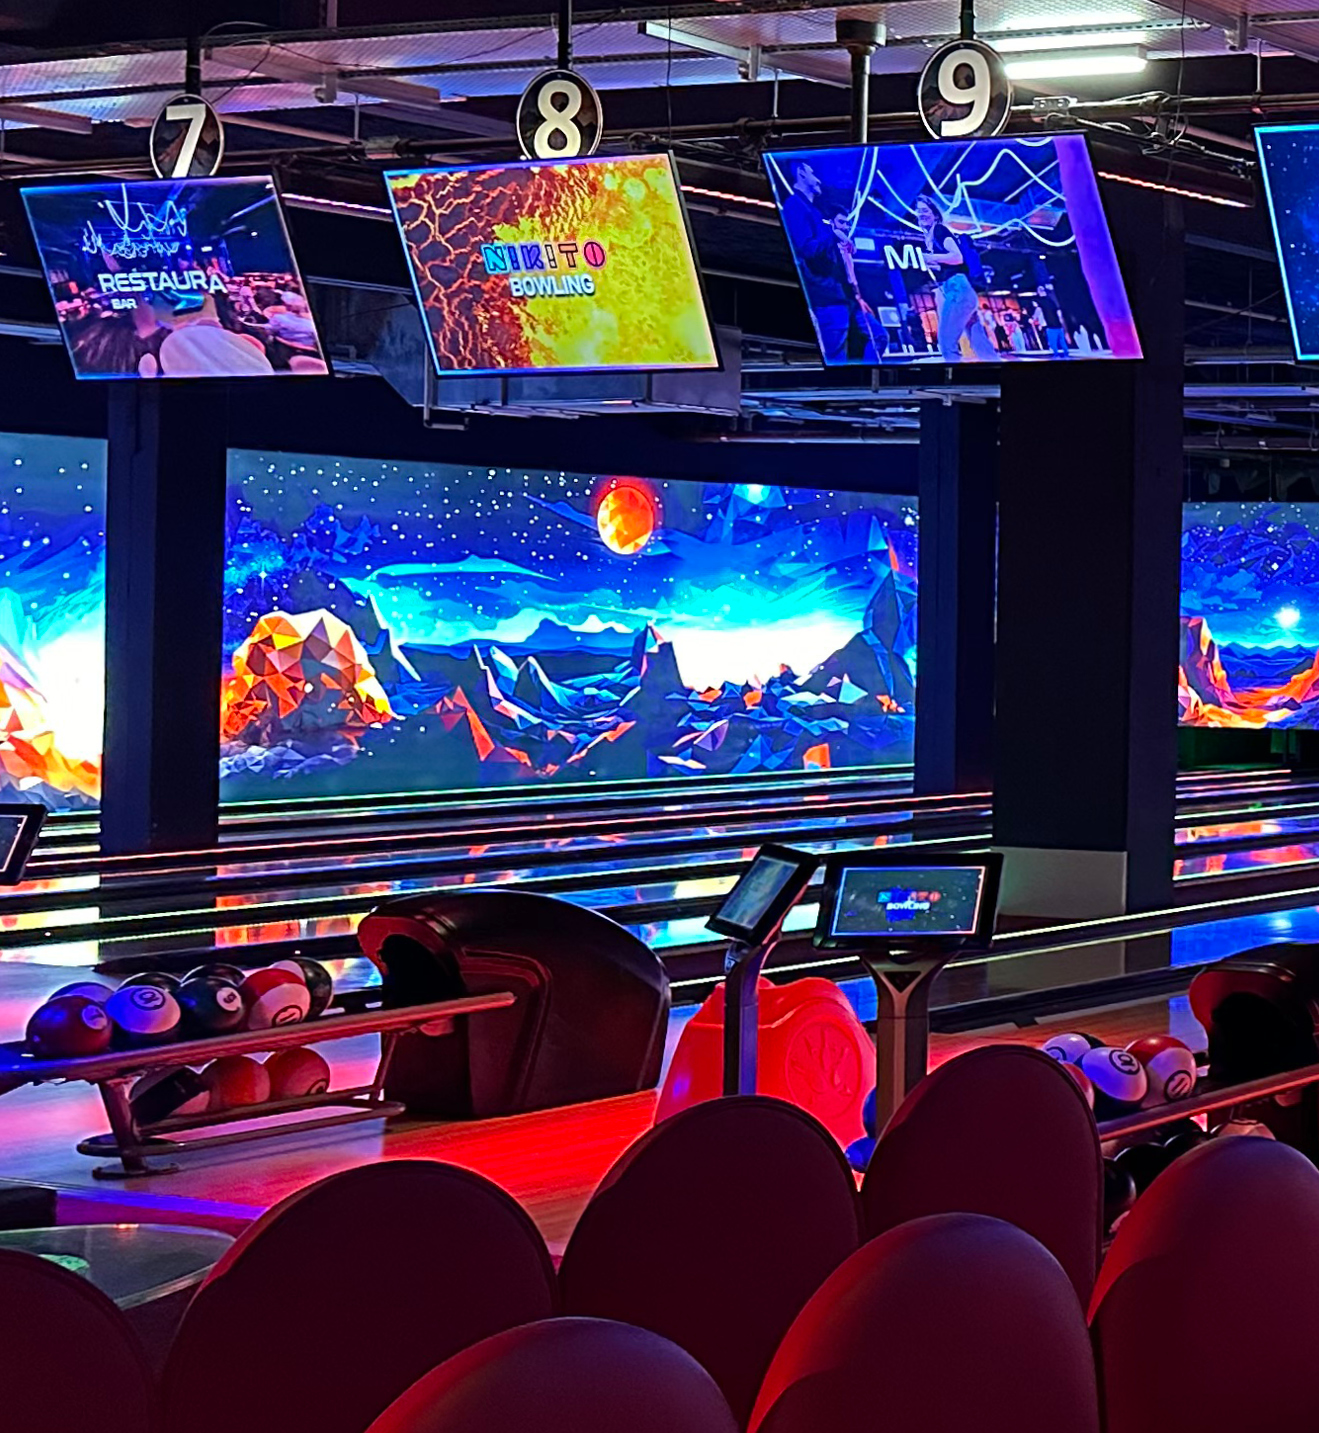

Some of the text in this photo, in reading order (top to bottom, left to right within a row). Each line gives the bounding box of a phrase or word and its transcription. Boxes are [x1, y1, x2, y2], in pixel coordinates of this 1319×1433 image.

[938, 48, 991, 137] 9
[165, 103, 207, 178] 7
[534, 79, 582, 159] 8
[98, 270, 228, 294] RESTAURA
[111, 298, 138, 310] BAR
[510, 273, 595, 297] BOWLING
